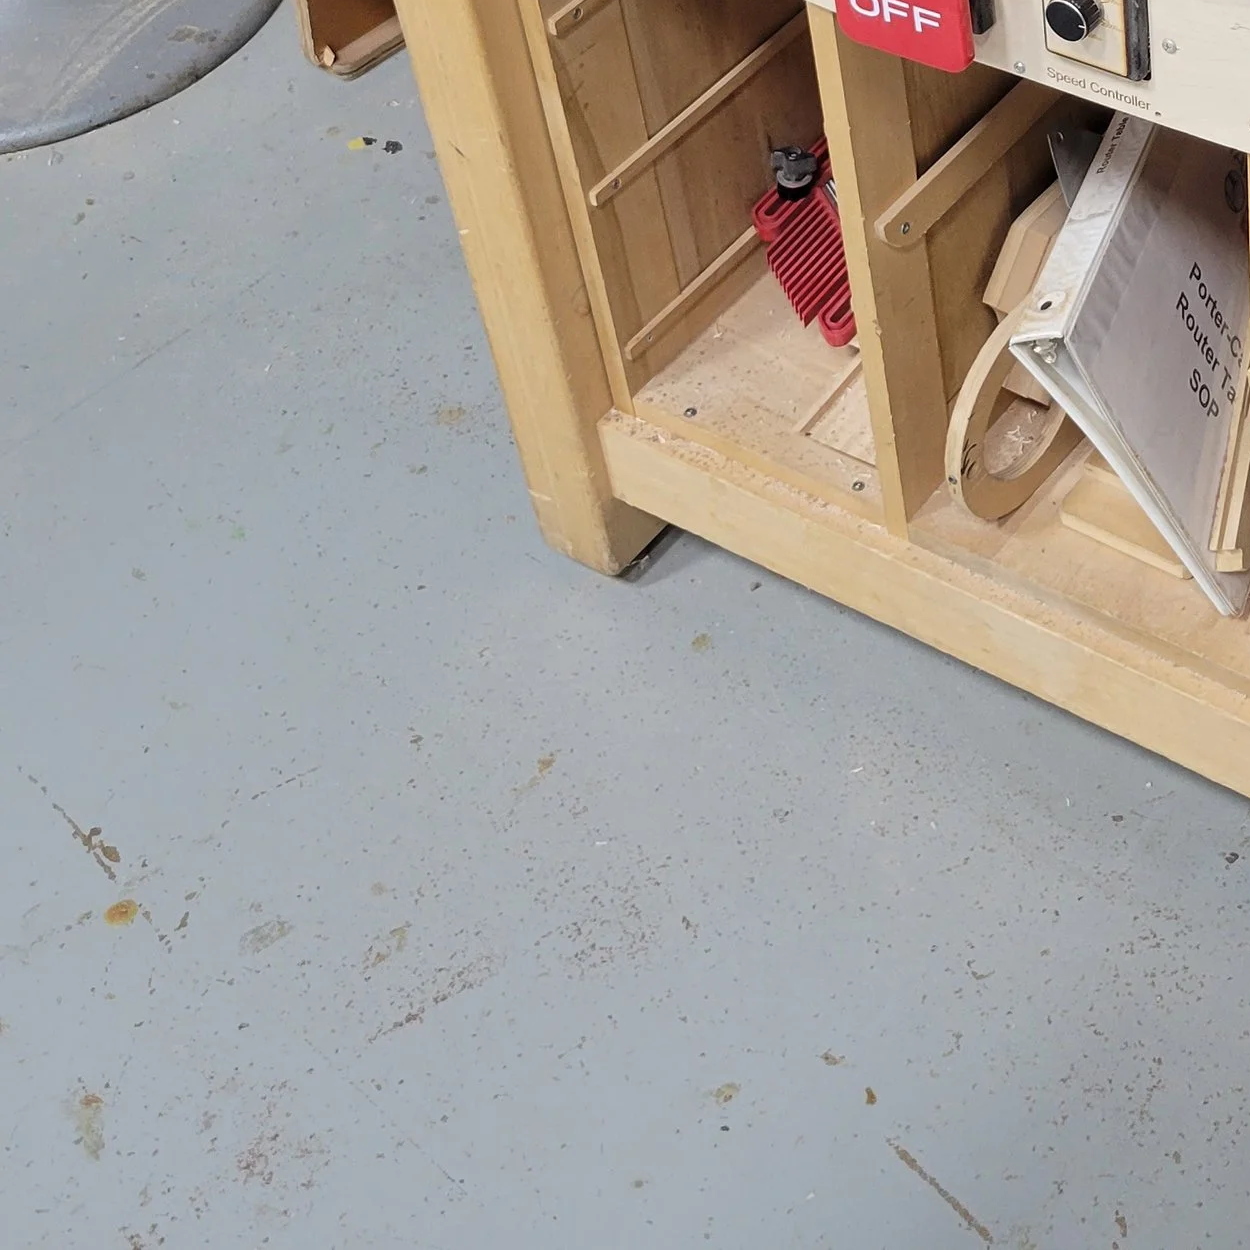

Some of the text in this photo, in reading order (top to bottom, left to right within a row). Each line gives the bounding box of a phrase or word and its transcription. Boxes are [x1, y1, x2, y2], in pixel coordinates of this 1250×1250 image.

[1047, 67, 1152, 110] Speed Controller
[1096, 117, 1129, 174] Router Table
[1176, 292, 1220, 371] Router
[1189, 368, 1219, 418] SOP
